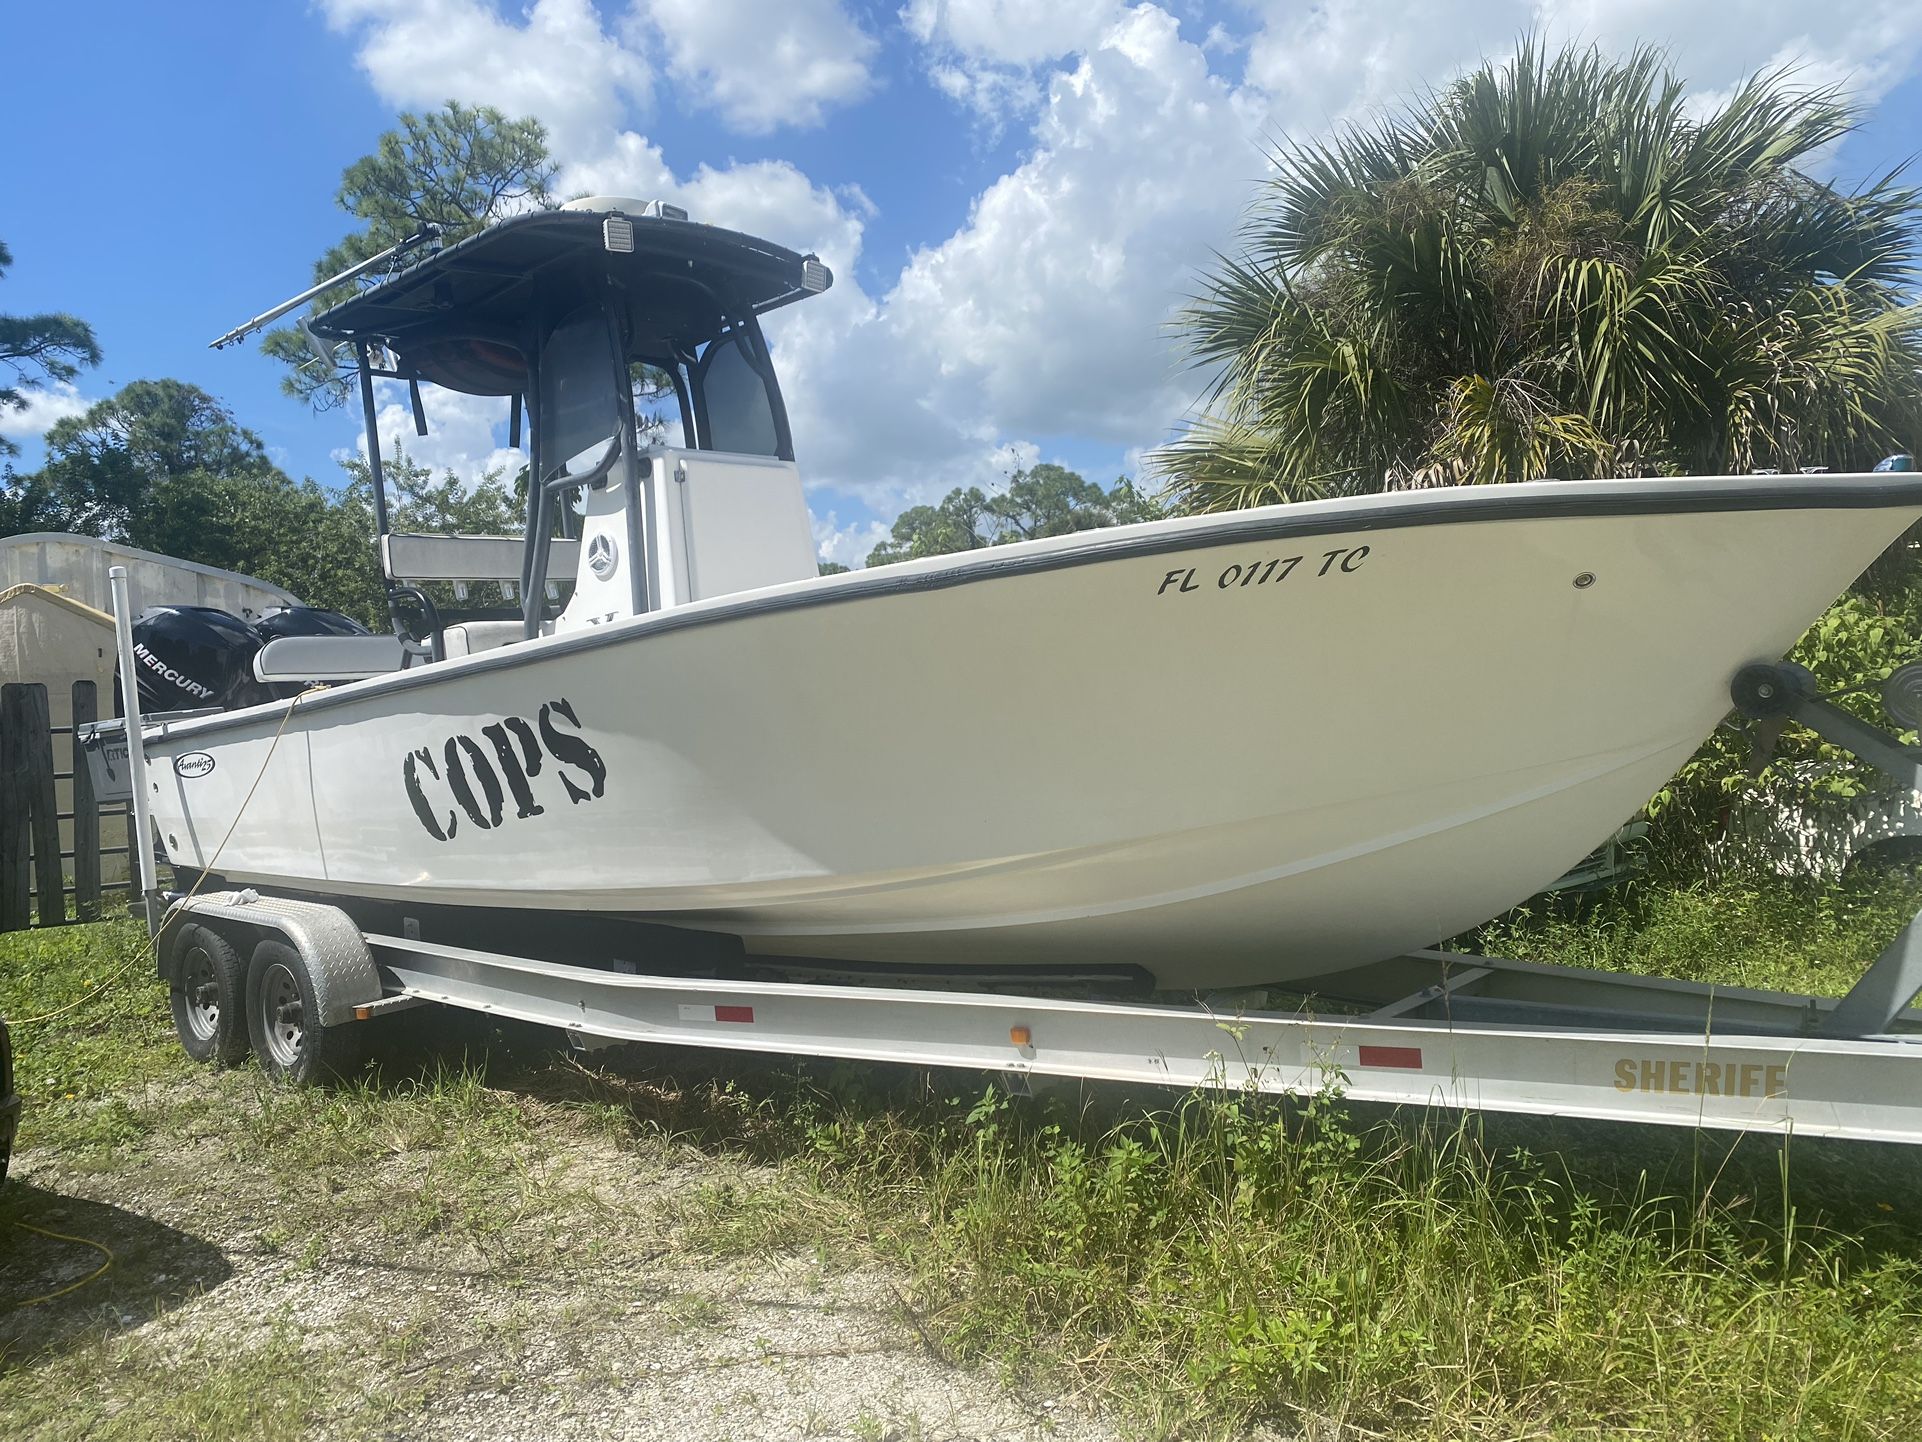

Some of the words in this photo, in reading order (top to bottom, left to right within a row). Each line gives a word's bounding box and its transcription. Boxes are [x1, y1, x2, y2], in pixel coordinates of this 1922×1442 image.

[1157, 567, 1200, 595] FL
[1217, 555, 1304, 589] 0117
[1317, 545, 1371, 577] TC
[133, 642, 215, 699] MERCURY
[403, 697, 607, 842] COPS
[1613, 1058, 1787, 1099] SHERIFF
